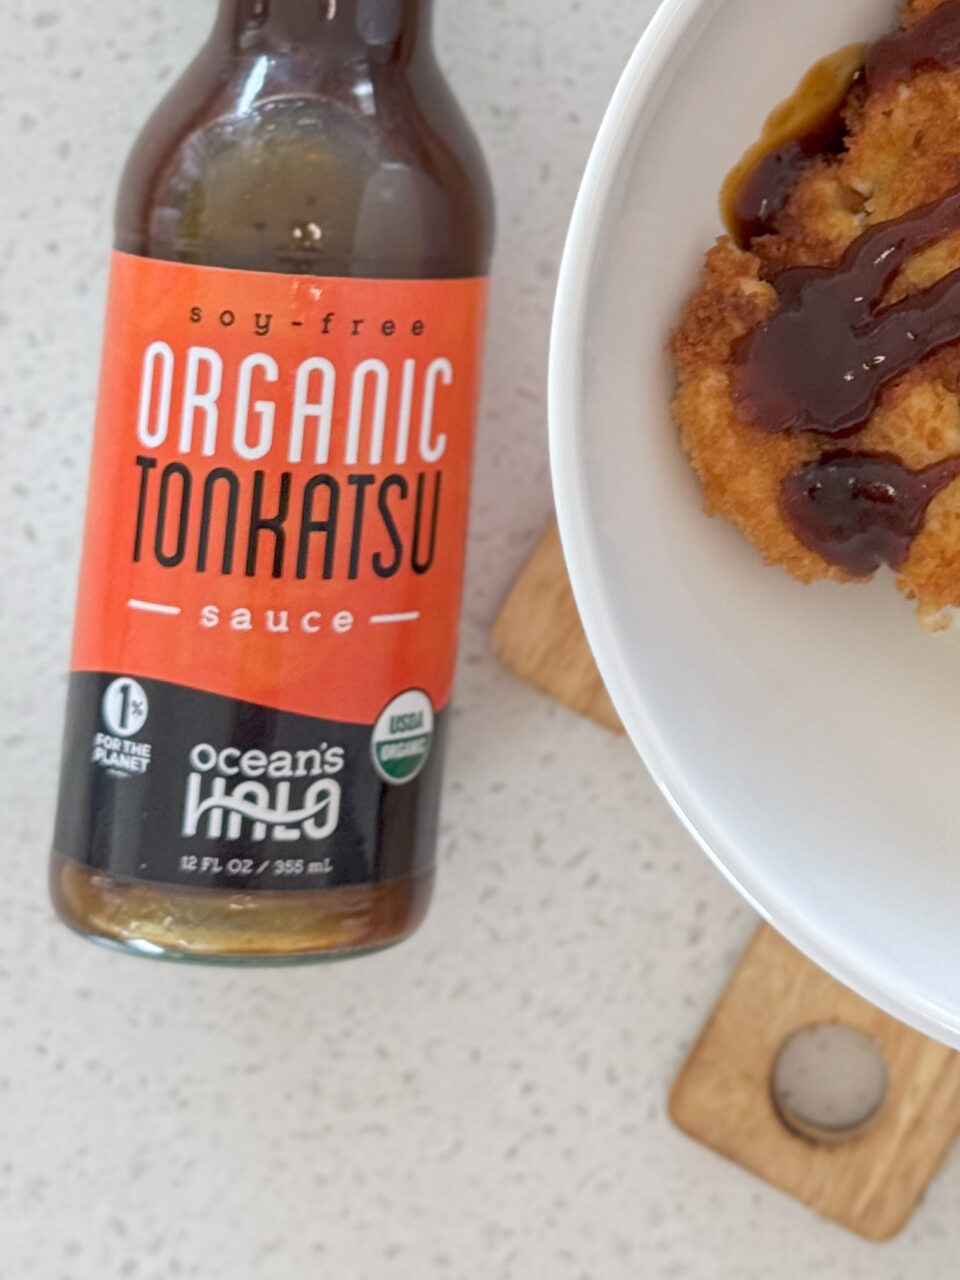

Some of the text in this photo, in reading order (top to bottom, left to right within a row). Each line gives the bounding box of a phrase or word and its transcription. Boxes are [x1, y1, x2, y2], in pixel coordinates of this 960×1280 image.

[189, 305, 426, 337] soy-free
[136, 341, 454, 465] ORGANIC
[132, 455, 442, 581] TONKATSU
[200, 604, 355, 634] sauce
[118, 683, 145, 730] 1%
[389, 710, 424, 735] USDA
[91, 746, 152, 775] PLANET
[93, 732, 152, 758] FOR THE
[181, 772, 342, 842] HALO
[179, 854, 199, 872] 12
[200, 856, 224, 874] FL
[226, 858, 255, 876] OZ
[271, 859, 305, 876] 355
